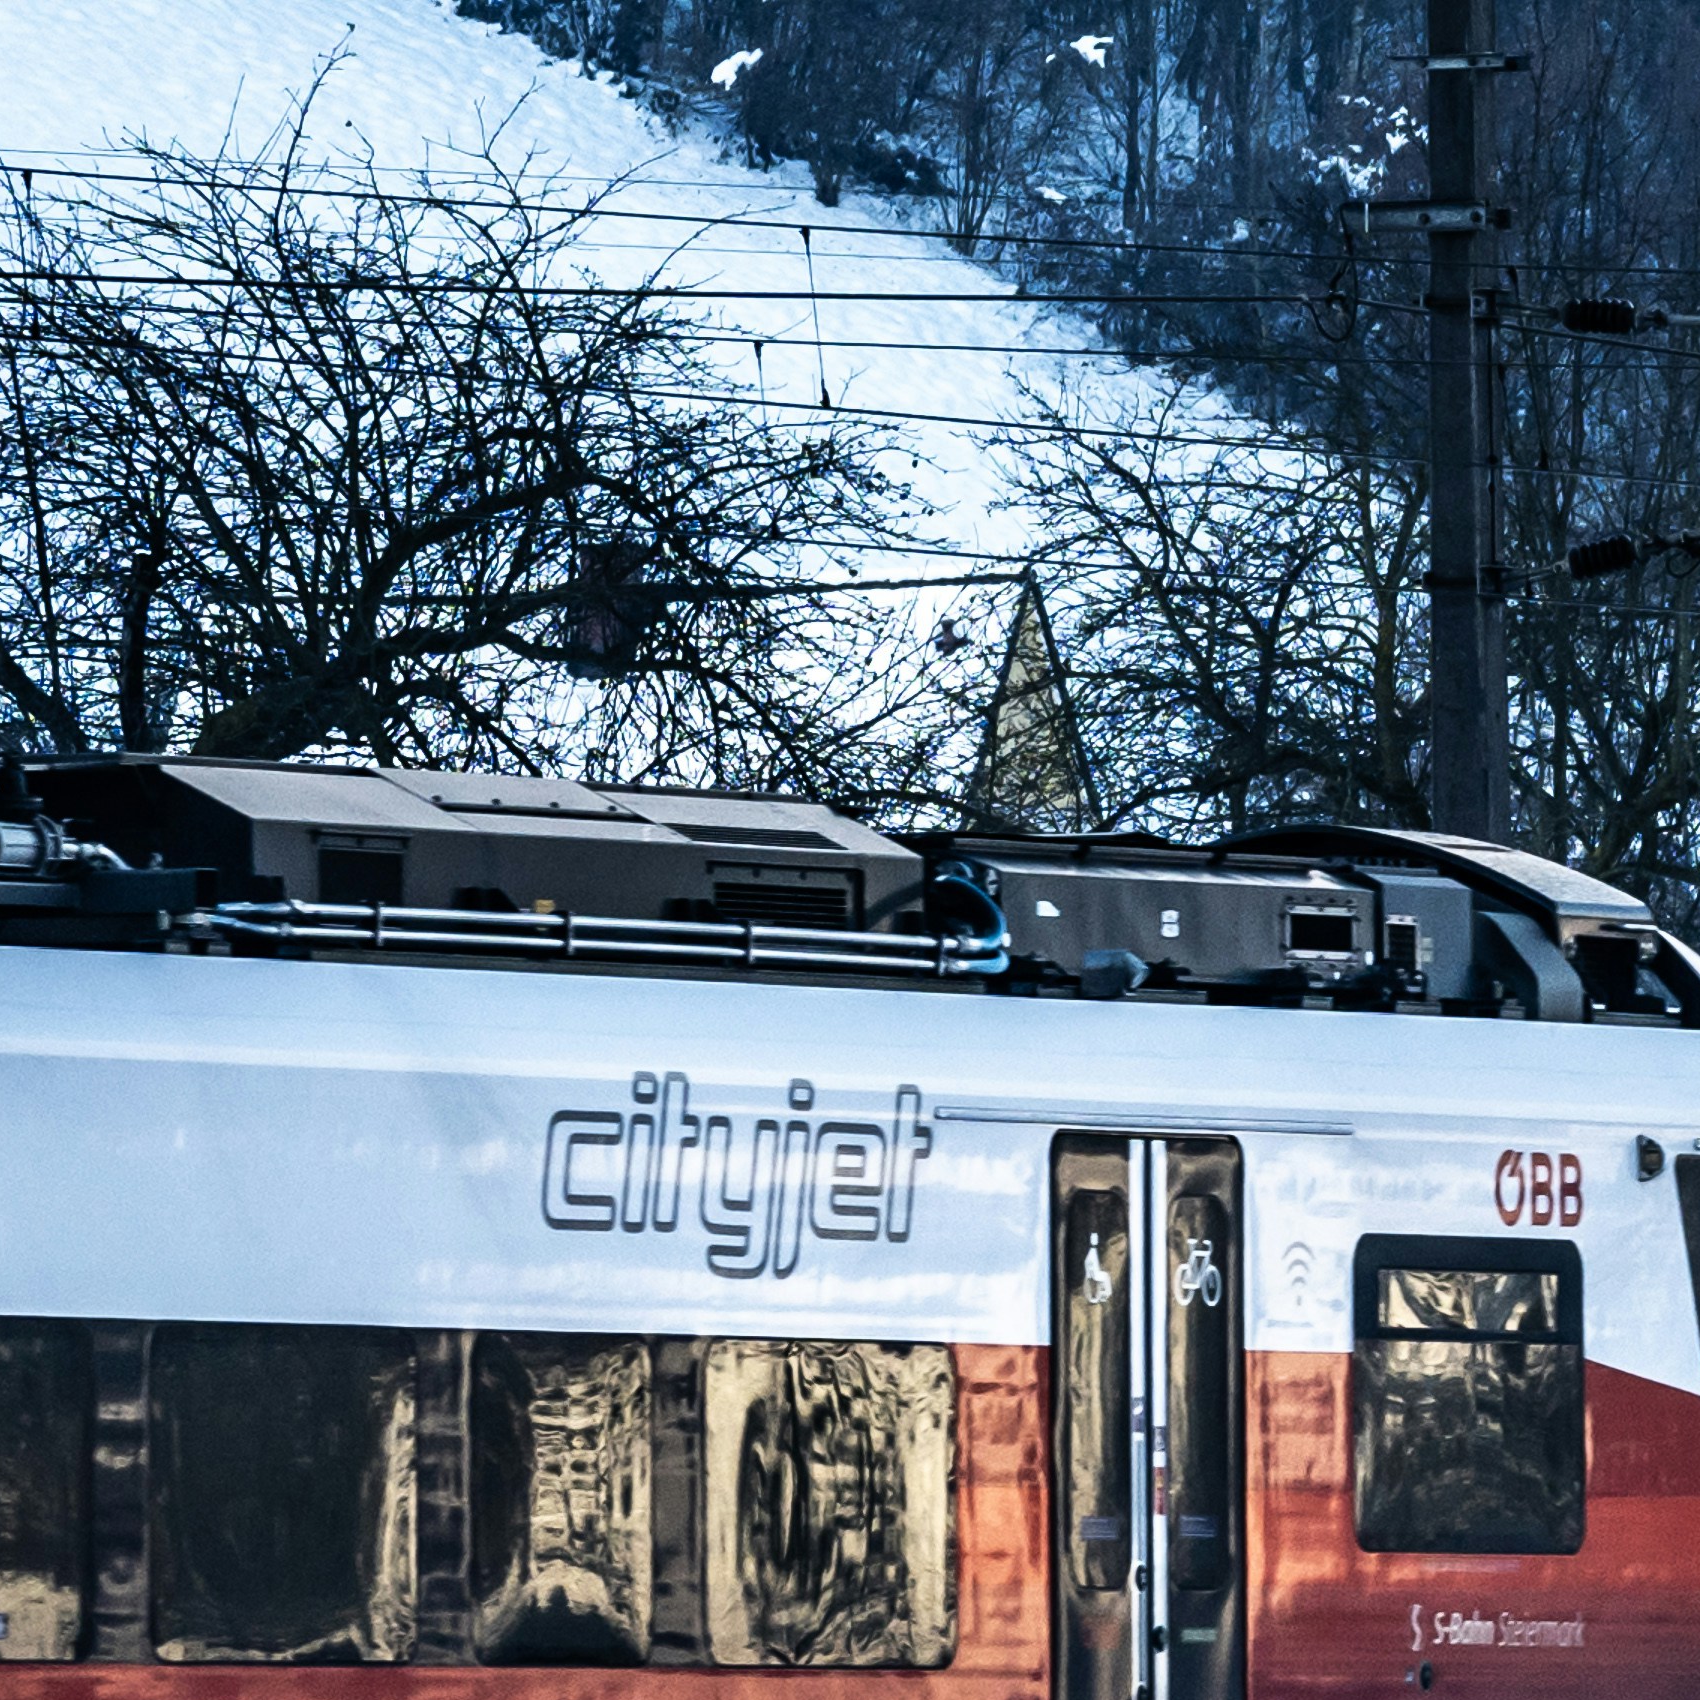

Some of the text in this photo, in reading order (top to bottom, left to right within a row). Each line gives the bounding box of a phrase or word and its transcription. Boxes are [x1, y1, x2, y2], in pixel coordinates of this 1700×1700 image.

[542, 1071, 933, 1280] cityjet
[1495, 1149, 1584, 1227] ÖBB
[1432, 1610, 1495, 1645] S-Bahn
